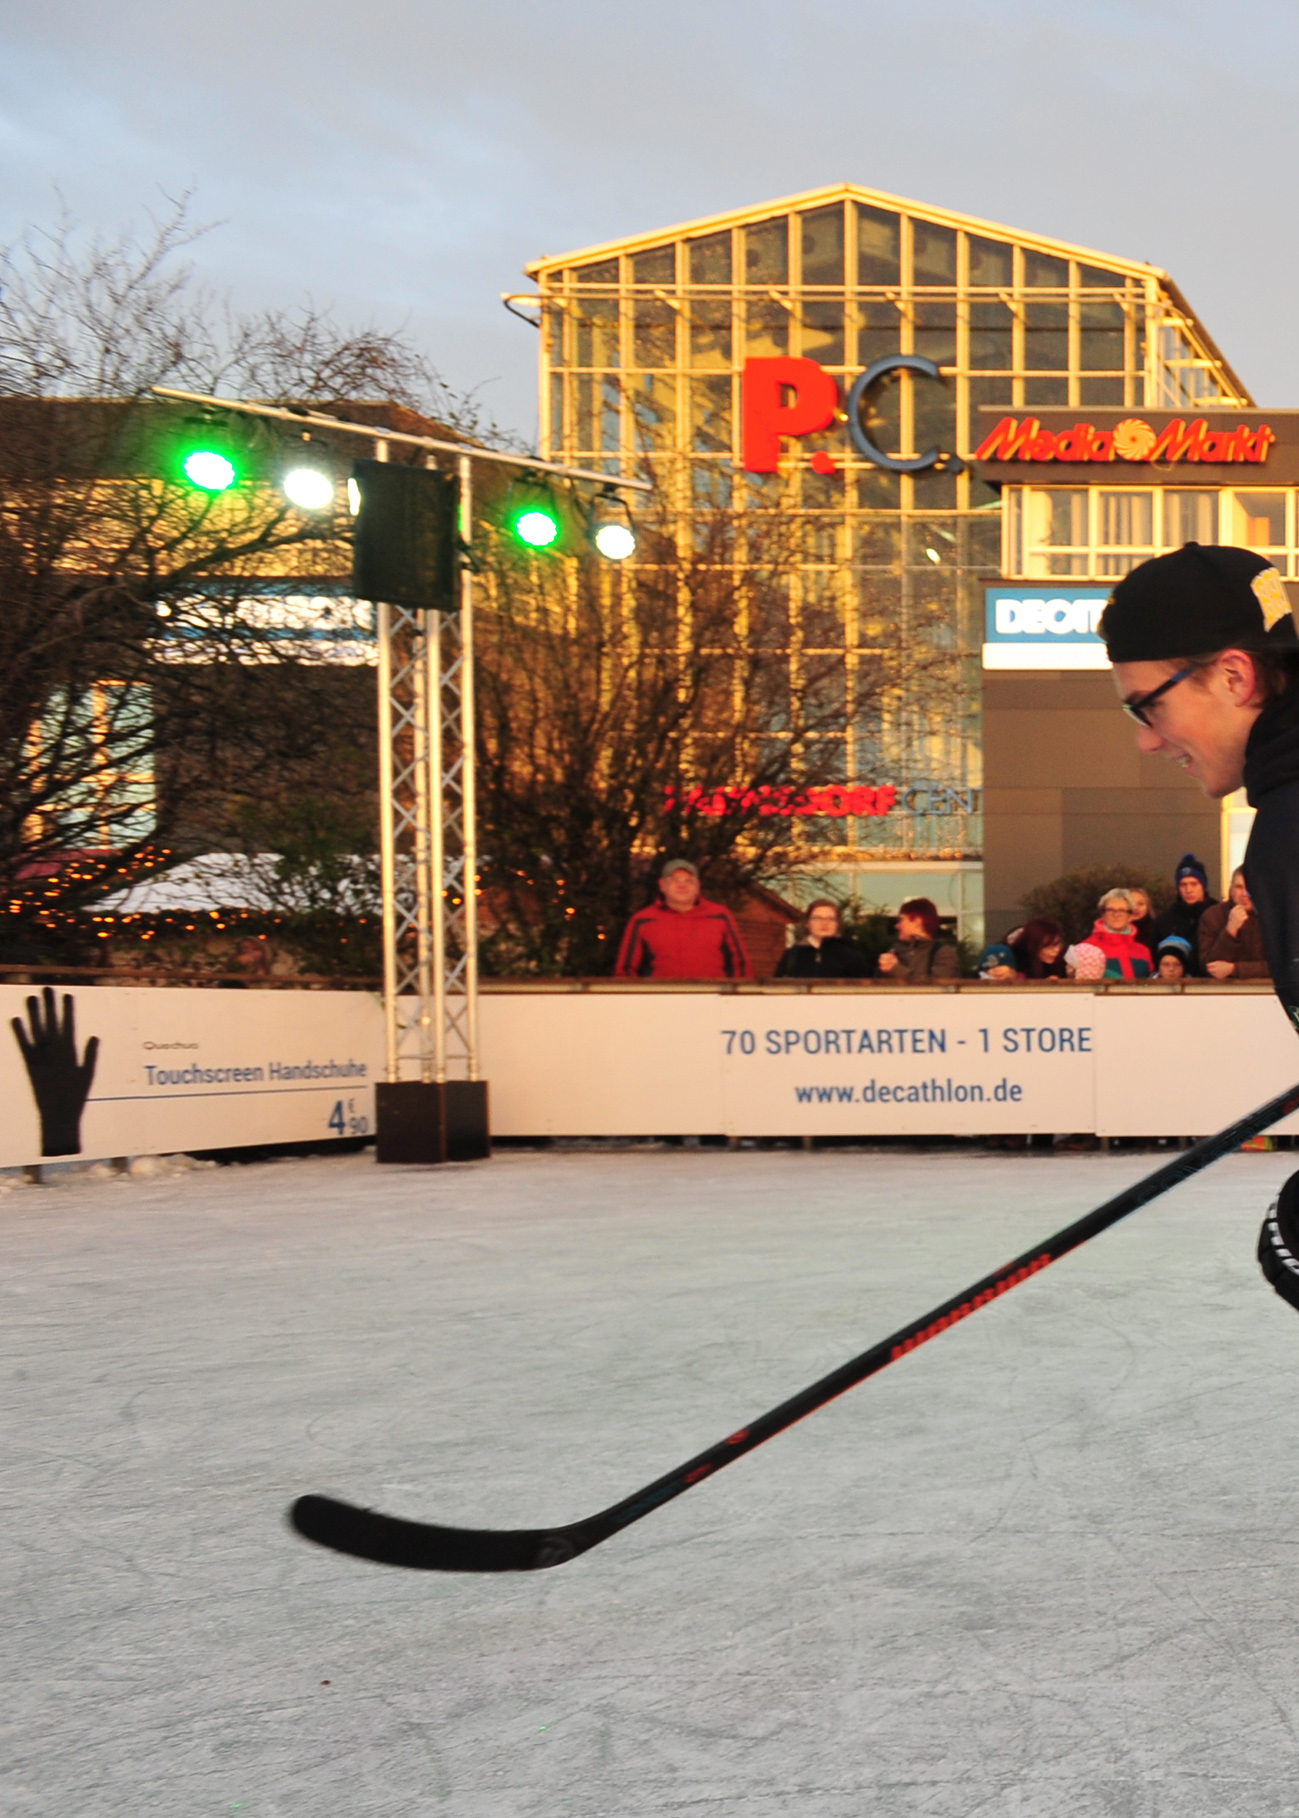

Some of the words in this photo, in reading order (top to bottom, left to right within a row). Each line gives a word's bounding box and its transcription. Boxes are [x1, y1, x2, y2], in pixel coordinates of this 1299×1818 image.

[974, 416, 1115, 461] Media
[1147, 417, 1276, 462] Markt
[721, 1030, 755, 1054] 70
[765, 1029, 946, 1054] SPORTARTEN
[978, 1028, 990, 1053] 1
[1002, 1027, 1092, 1052] STORE
[144, 1063, 264, 1085] Touchscreen
[268, 1059, 366, 1081] Handschuhe
[795, 1078, 1023, 1103] www.decathlon.de
[328, 1100, 346, 1135] 4
